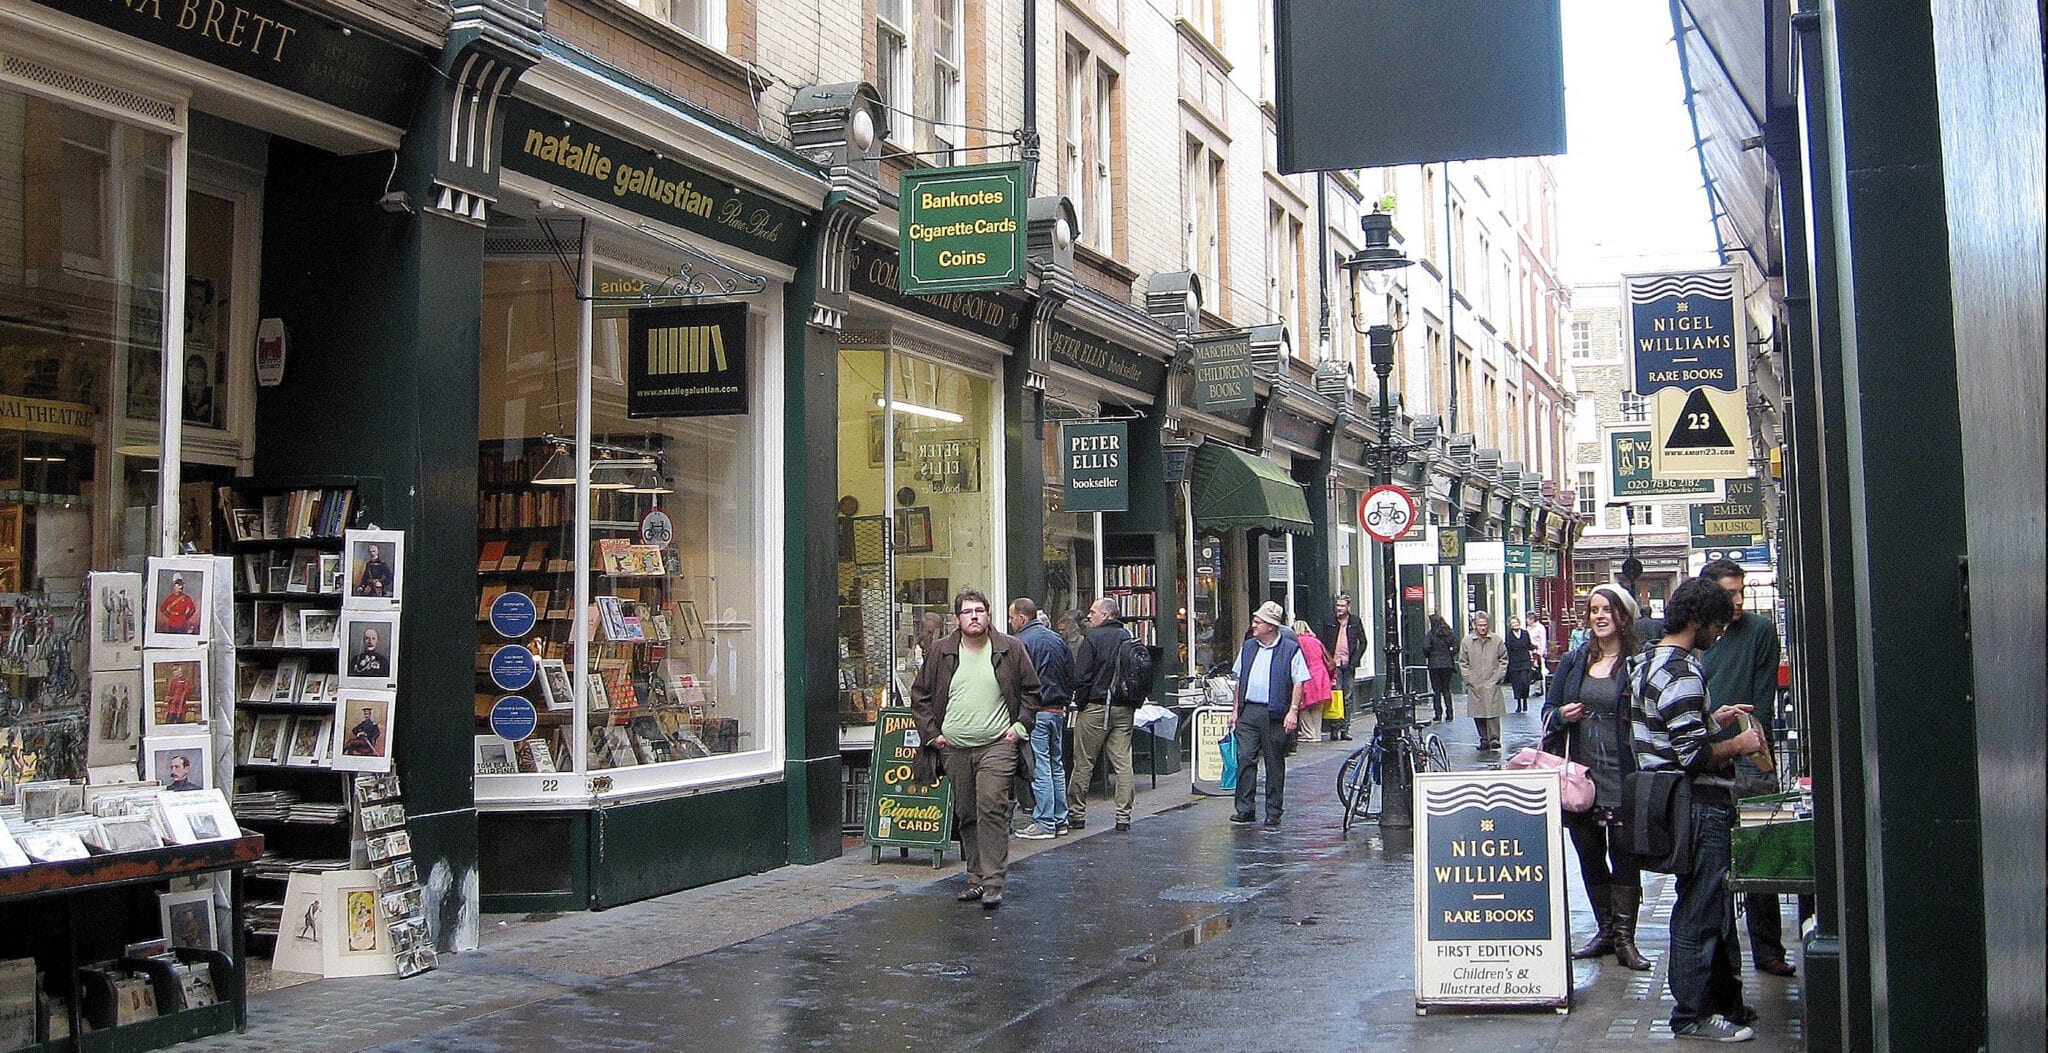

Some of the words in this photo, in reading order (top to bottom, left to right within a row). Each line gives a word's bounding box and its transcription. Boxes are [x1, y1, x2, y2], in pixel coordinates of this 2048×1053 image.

[176, 0, 297, 62] BRETT
[524, 128, 611, 181] natalie
[613, 162, 714, 219] galustian
[921, 189, 1004, 210] Banknotes
[909, 223, 973, 242] Cigarette
[974, 217, 1017, 235] Cards
[938, 249, 987, 268] Coins
[869, 258, 899, 291] COLI
[963, 295, 987, 320] SON
[985, 301, 1004, 327] LTD
[1654, 316, 1713, 332] NIGEL
[1053, 332, 1081, 359] PETER
[1081, 343, 1108, 368] ELLIS
[1196, 342, 1248, 360] MARCHPANE
[1640, 334, 1731, 352] WILLIAMS
[1649, 370, 1680, 382] RARE
[1682, 368, 1723, 381] BOOKS
[636, 385, 738, 397] www.nataliegalustian.com
[1209, 382, 1242, 398] BOOKS
[25, 405, 94, 427] THEATRE
[1687, 413, 1710, 430] 23
[1071, 435, 1120, 452] PETER
[1072, 453, 1119, 470] ELLIS
[1072, 477, 1119, 489] bookseller
[1628, 480, 1649, 489] 020
[1728, 483, 1753, 493] AVIS
[1713, 505, 1751, 516] EMERY
[1713, 522, 1753, 533] MUSIC
[1202, 714, 1231, 725] PET
[542, 779, 558, 792] 22
[878, 797, 943, 823] Cigarette
[898, 820, 940, 832] CARDS
[1452, 839, 1524, 858] NIGEL
[1434, 864, 1544, 884] WILLIAMS
[1444, 910, 1481, 923] RARE
[1485, 909, 1535, 922] BOOKS
[1437, 945, 1472, 957] FIRST
[1478, 944, 1543, 957] EDITIONS
[1453, 967, 1513, 980] Children's
[1517, 968, 1529, 979] &
[1439, 982, 1500, 995] Illustrated
[1504, 982, 1542, 994] Books
